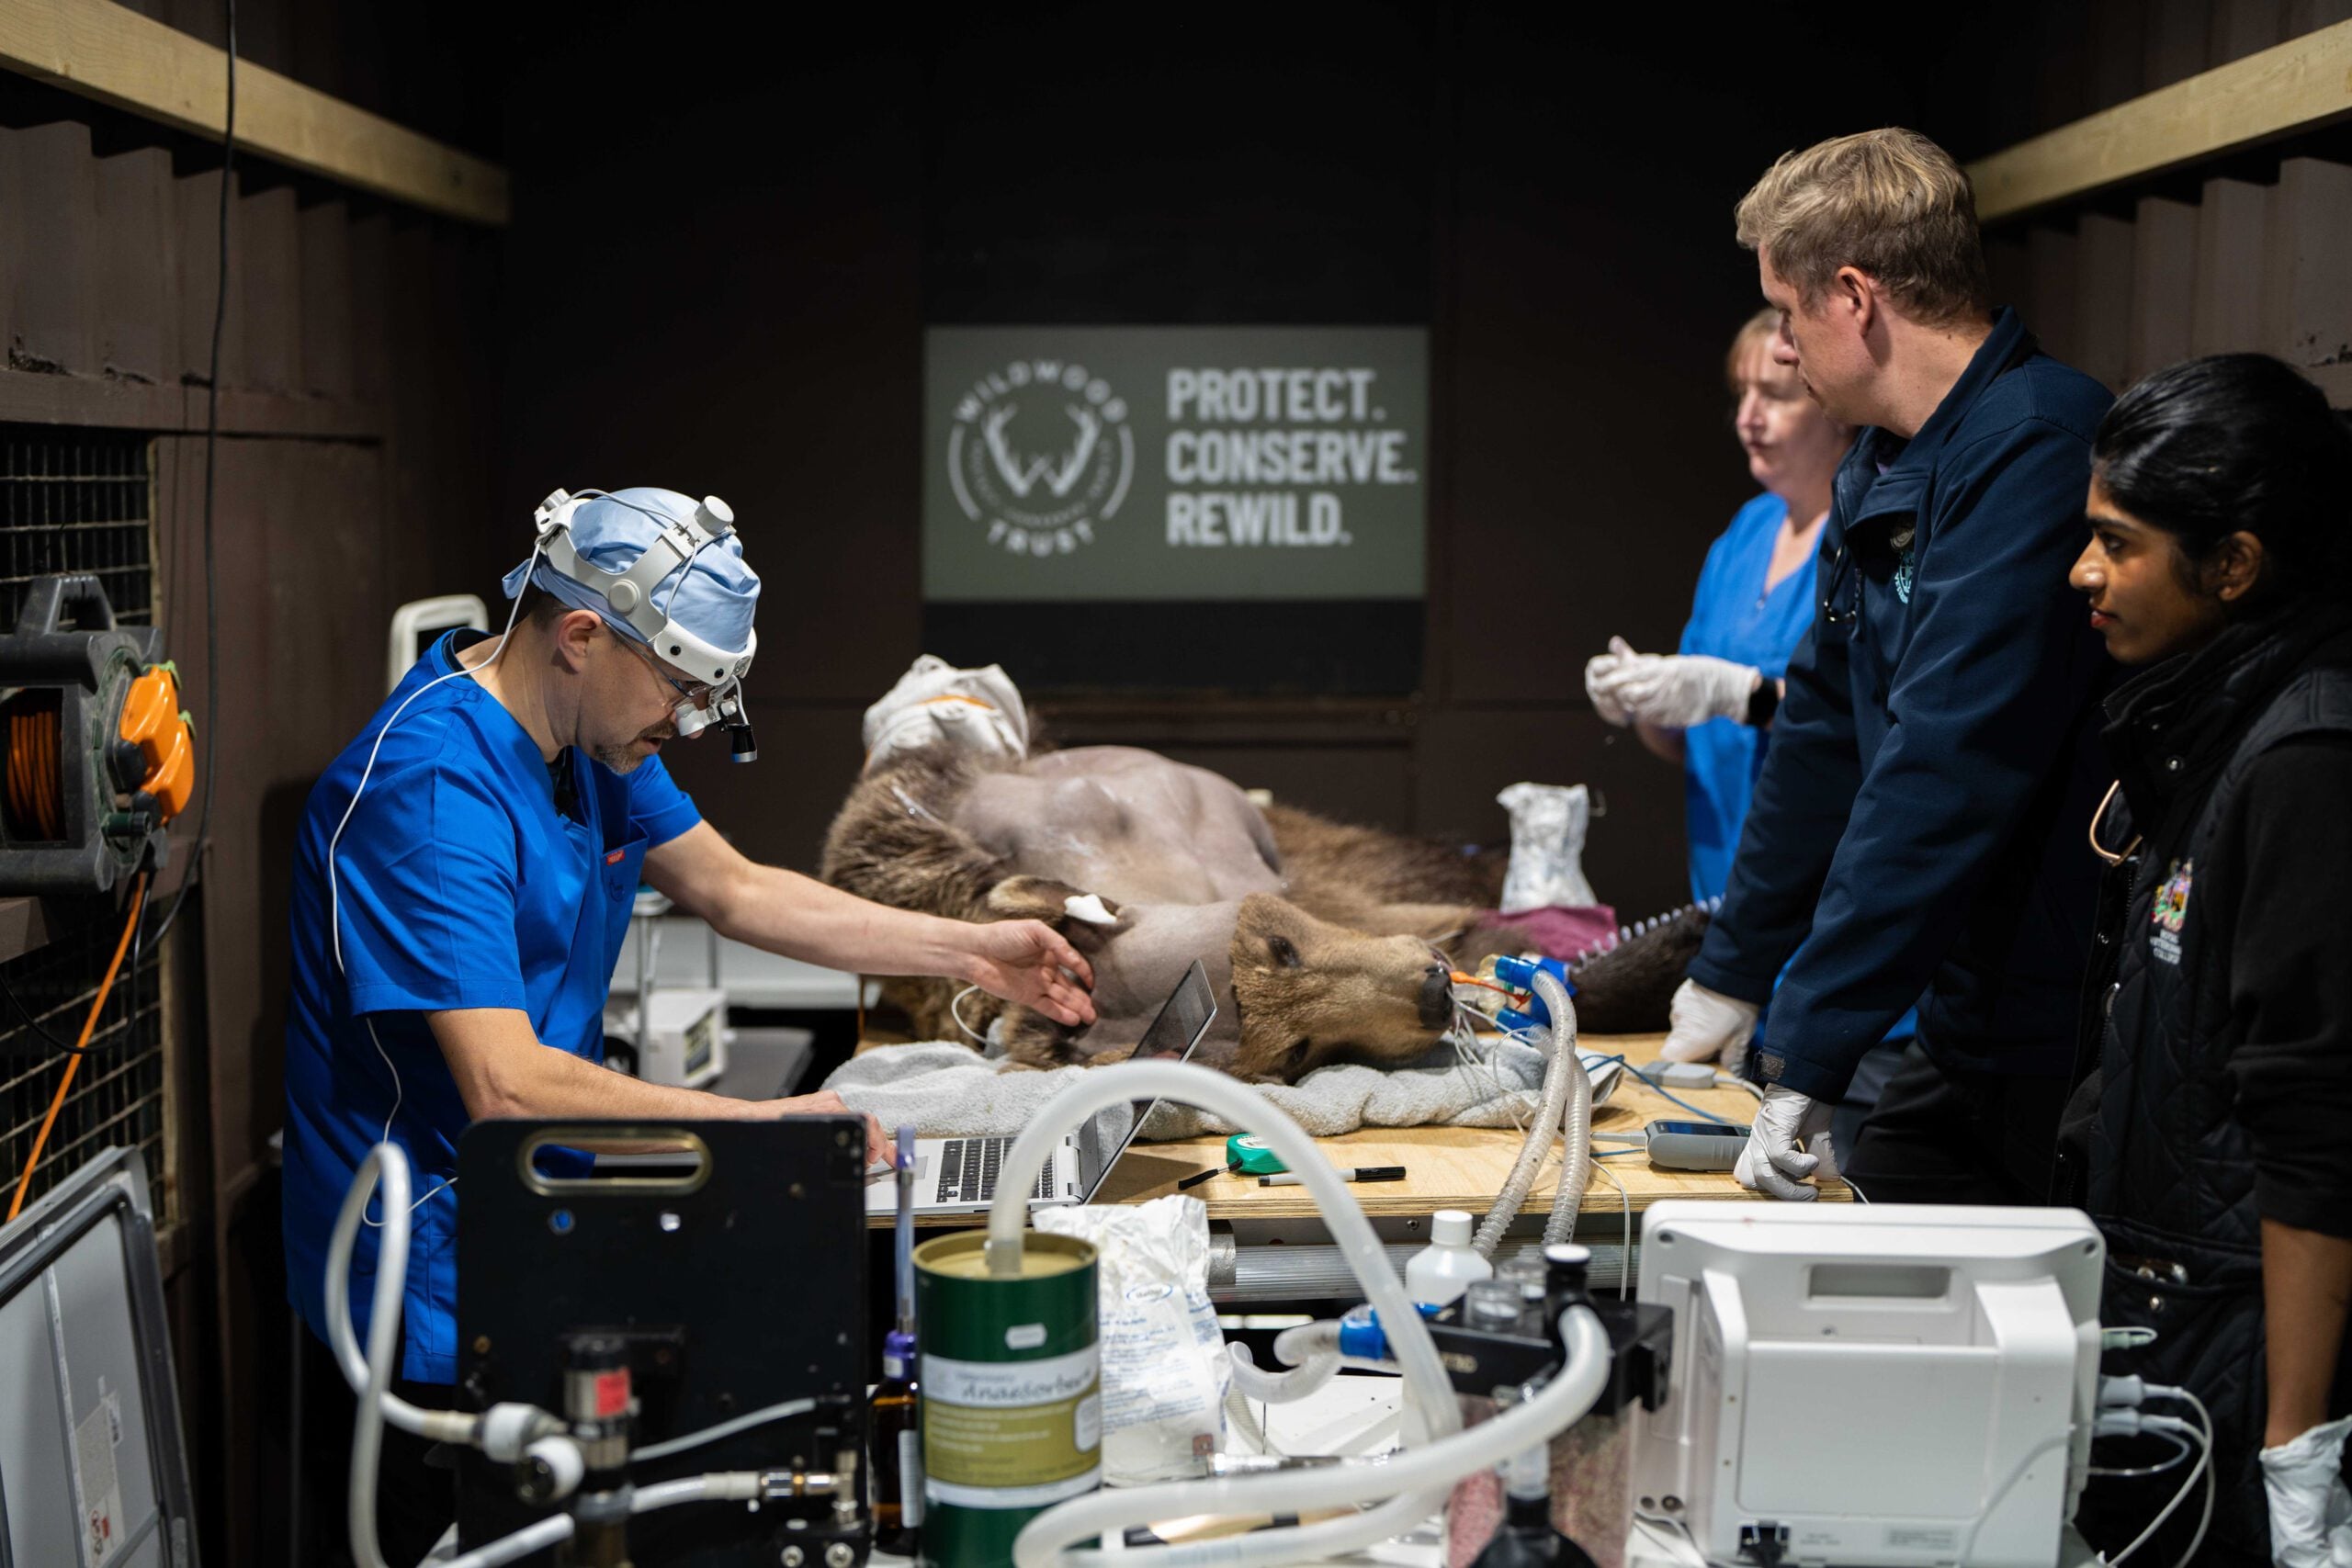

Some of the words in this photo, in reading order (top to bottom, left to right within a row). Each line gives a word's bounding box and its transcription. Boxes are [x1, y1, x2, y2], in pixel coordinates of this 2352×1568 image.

[955, 359, 1128, 423] WILDWOOD
[1167, 368, 1386, 421] PROTECT.
[1166, 430, 1418, 484] CONSERVE.
[988, 517, 1095, 558] TRUST
[1166, 492, 1353, 546] REWILD.
